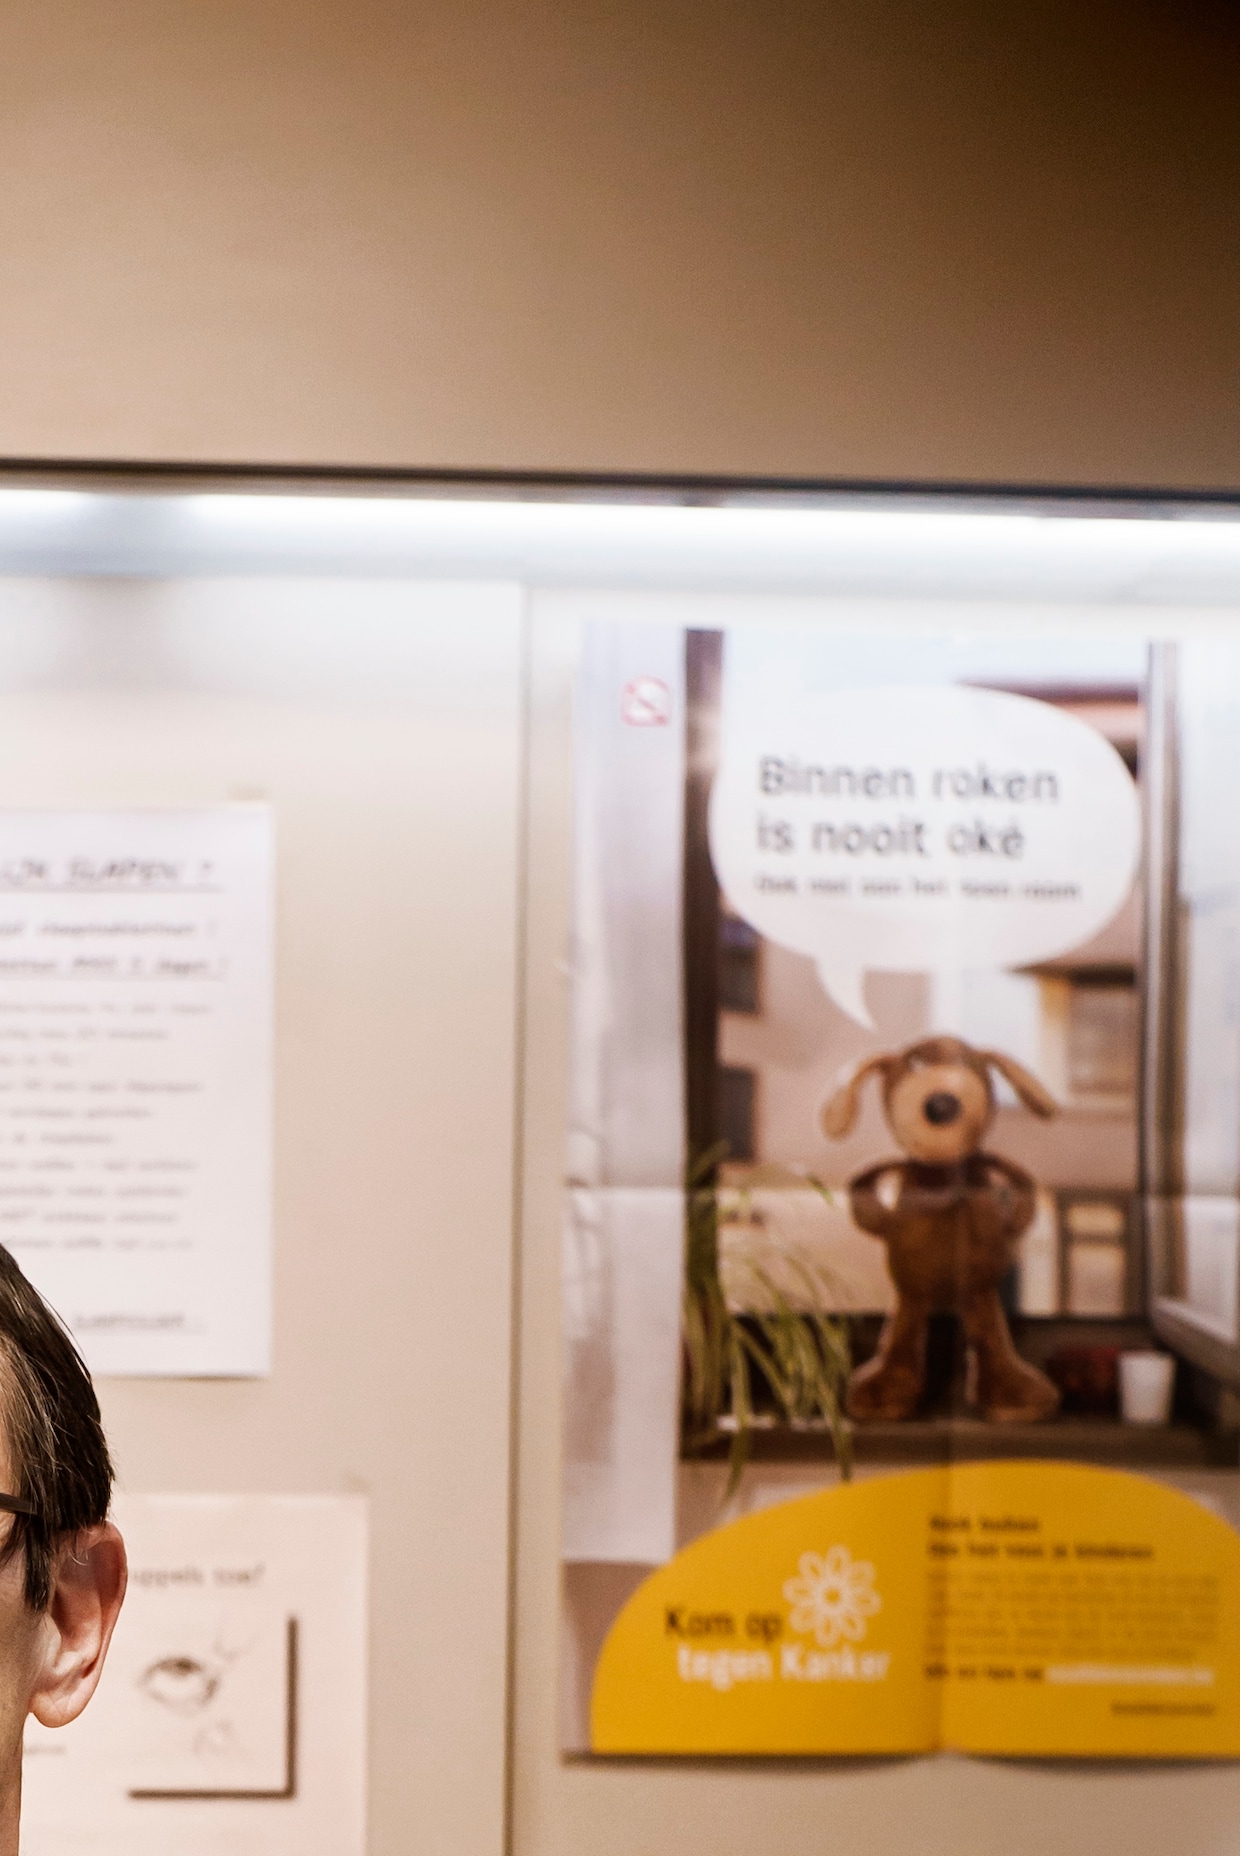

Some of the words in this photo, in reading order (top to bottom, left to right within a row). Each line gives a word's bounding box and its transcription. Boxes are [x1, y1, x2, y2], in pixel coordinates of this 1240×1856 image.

[757, 755, 917, 800] Binnen
[933, 760, 1061, 805] roken
[757, 811, 794, 854] is
[811, 812, 928, 857] nooit
[947, 814, 1025, 861] oké
[664, 1605, 736, 1639] Kom
[744, 1612, 783, 1645] op
[676, 1643, 773, 1692] tegen
[779, 1643, 892, 1683] Kanker
